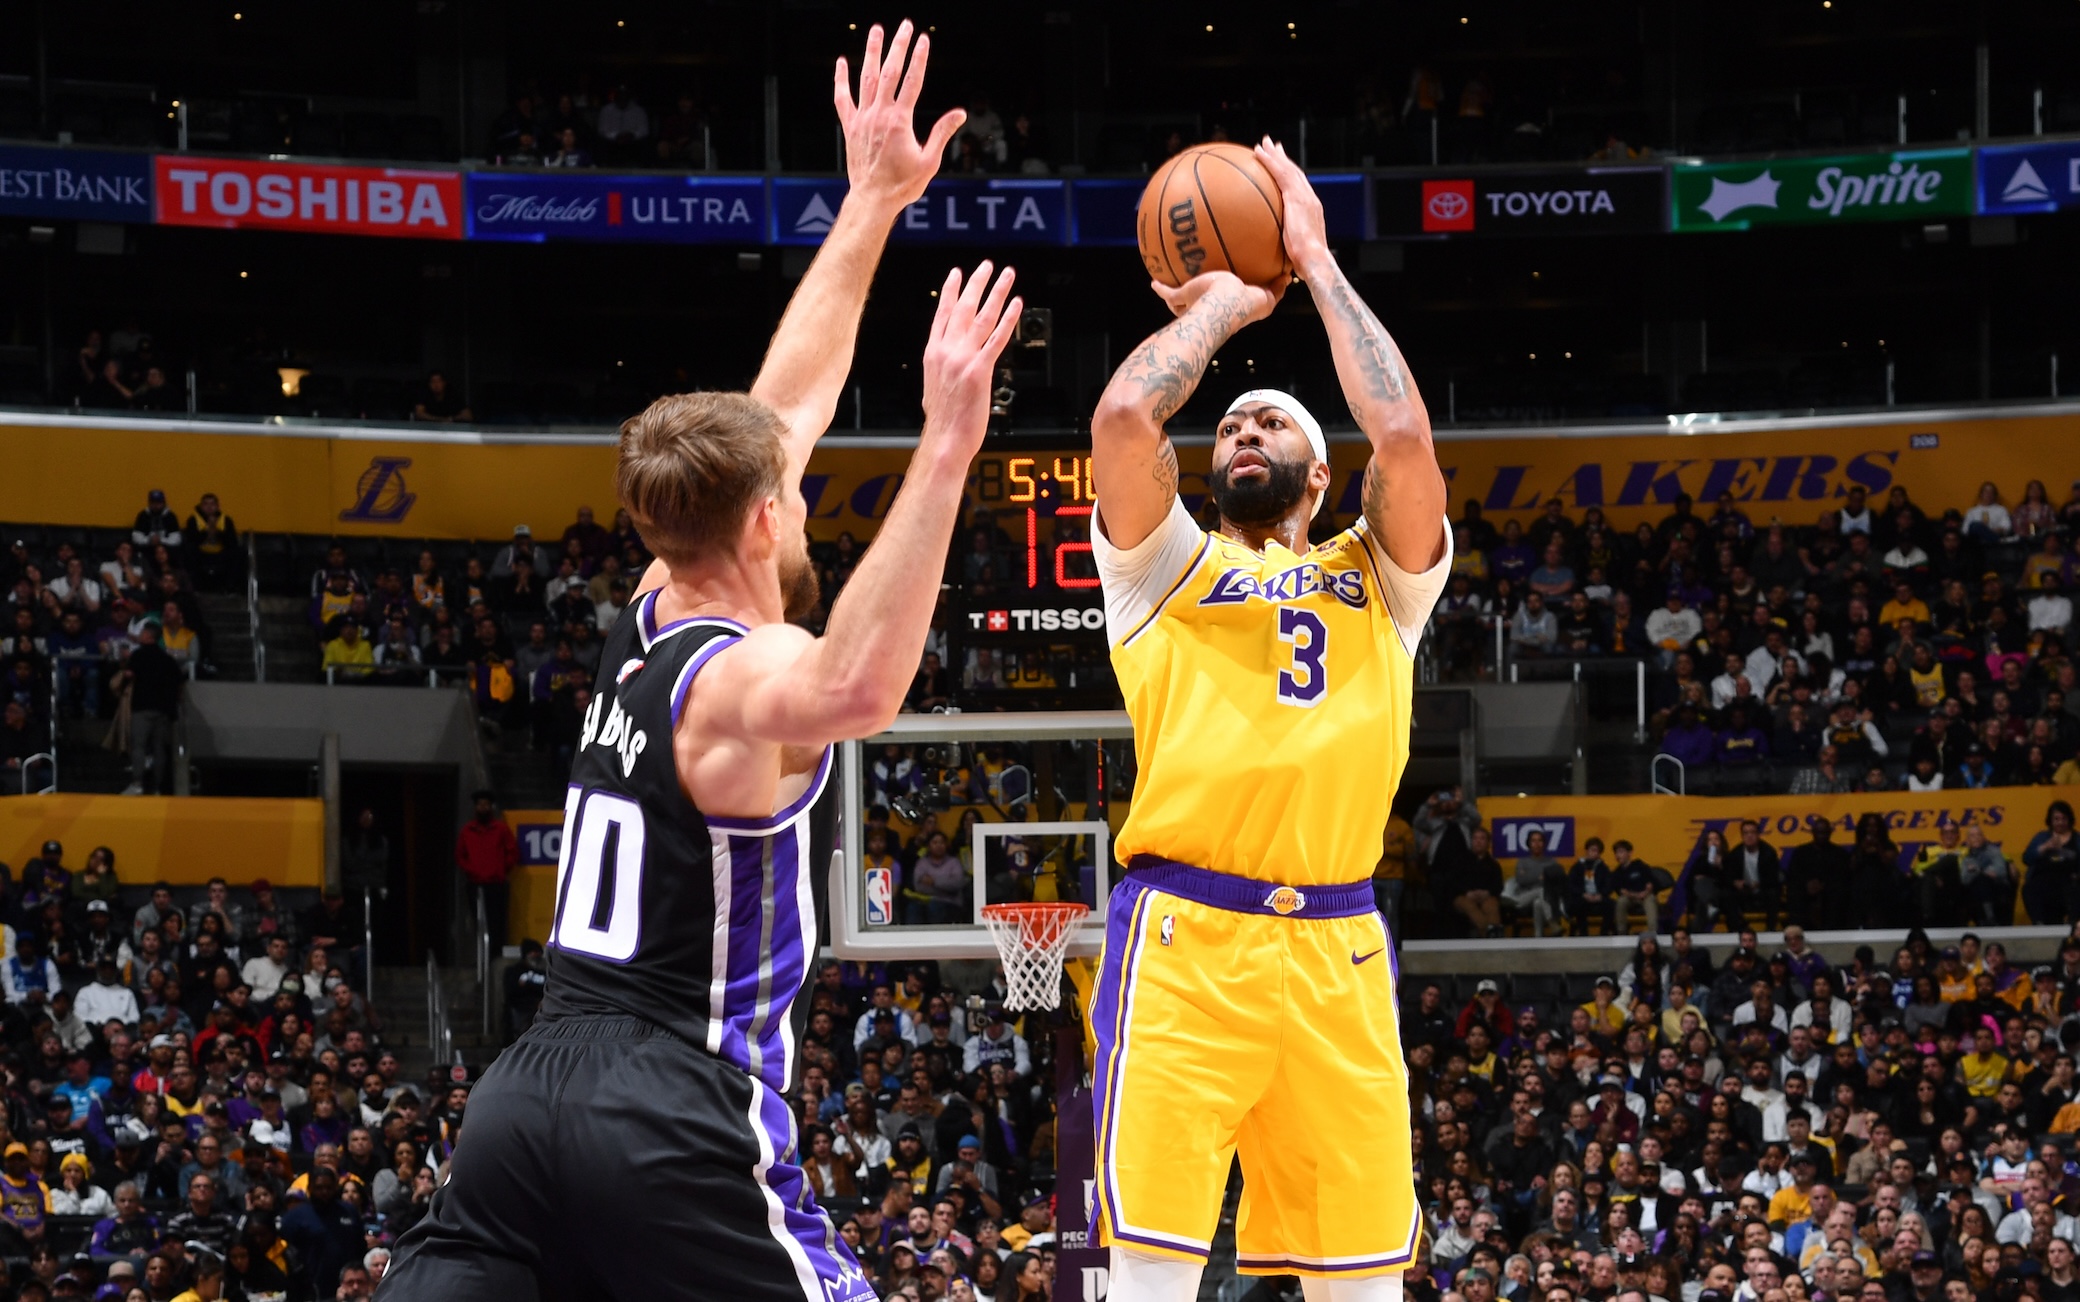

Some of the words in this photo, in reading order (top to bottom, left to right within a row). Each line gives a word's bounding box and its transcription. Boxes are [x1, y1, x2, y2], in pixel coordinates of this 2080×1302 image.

[54, 167, 147, 205] BANK
[169, 168, 448, 227] TOSHIBA
[477, 194, 598, 223] Michelob
[630, 196, 753, 224] ULTRA
[1485, 189, 1616, 217] TOYOTA
[1807, 161, 1942, 217] Sprite
[904, 195, 1047, 231] ELTA
[1168, 196, 1207, 278] Wils
[1481, 450, 1901, 511] LAKERS
[1026, 505, 1101, 589] 12
[1197, 561, 1370, 612] LAKERS
[1010, 607, 1106, 632] TISSO
[1276, 604, 1330, 710] 3
[1501, 821, 1566, 853] 107
[1831, 805, 2007, 832] AGELES
[546, 782, 646, 965] 10
